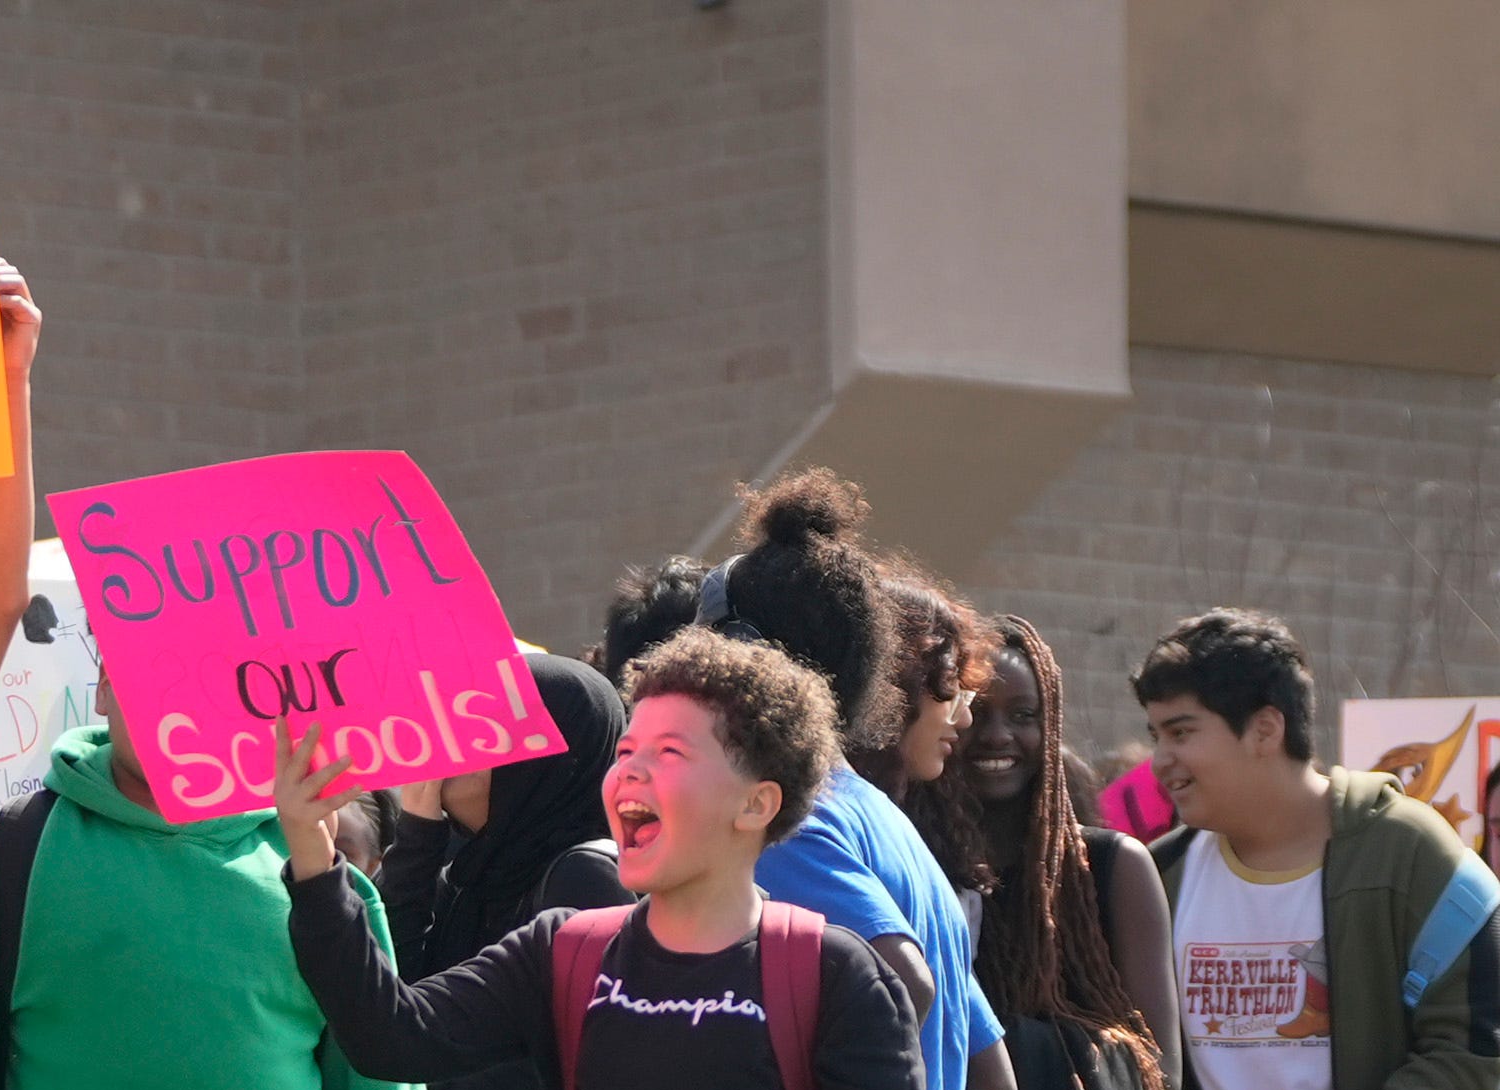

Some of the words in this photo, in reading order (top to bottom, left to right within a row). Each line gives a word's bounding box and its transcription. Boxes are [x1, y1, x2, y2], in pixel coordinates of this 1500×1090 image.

[77, 474, 463, 638] Support
[235, 648, 359, 721] our
[156, 658, 549, 808] Scools!
[1186, 985, 1299, 1015] TRIATHLON
[1189, 958, 1300, 985] KERRVILLE
